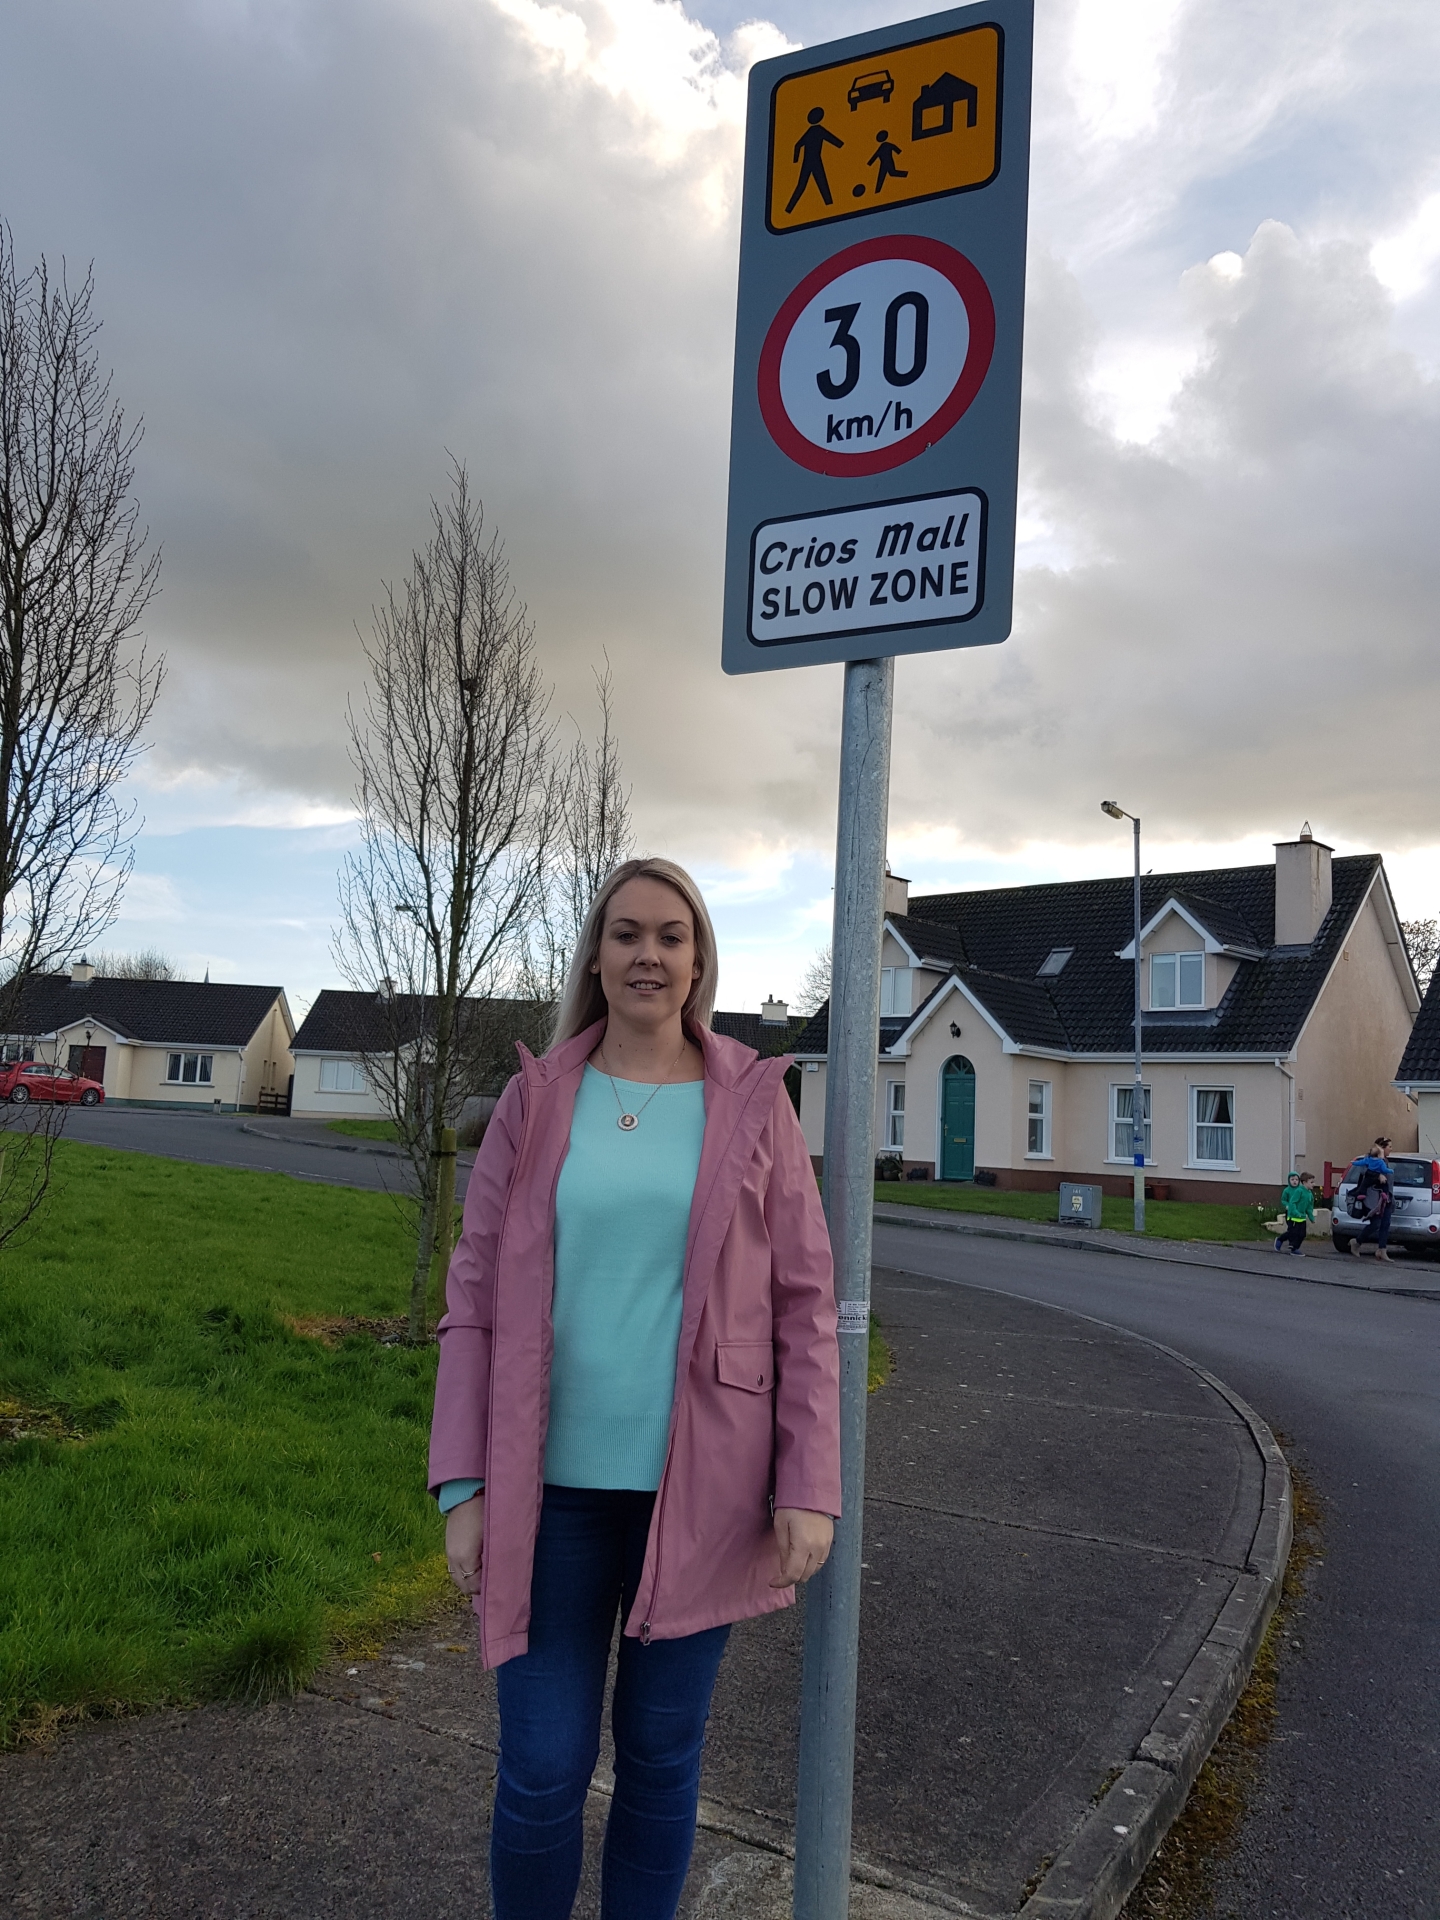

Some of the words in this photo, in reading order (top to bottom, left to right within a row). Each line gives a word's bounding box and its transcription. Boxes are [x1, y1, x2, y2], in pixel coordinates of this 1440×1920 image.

[815, 290, 930, 401] 30
[826, 400, 914, 444] km/h
[759, 535, 859, 577] Crios
[875, 512, 970, 560] Mall
[759, 575, 860, 621] SLOW
[869, 560, 970, 607] ZONE
